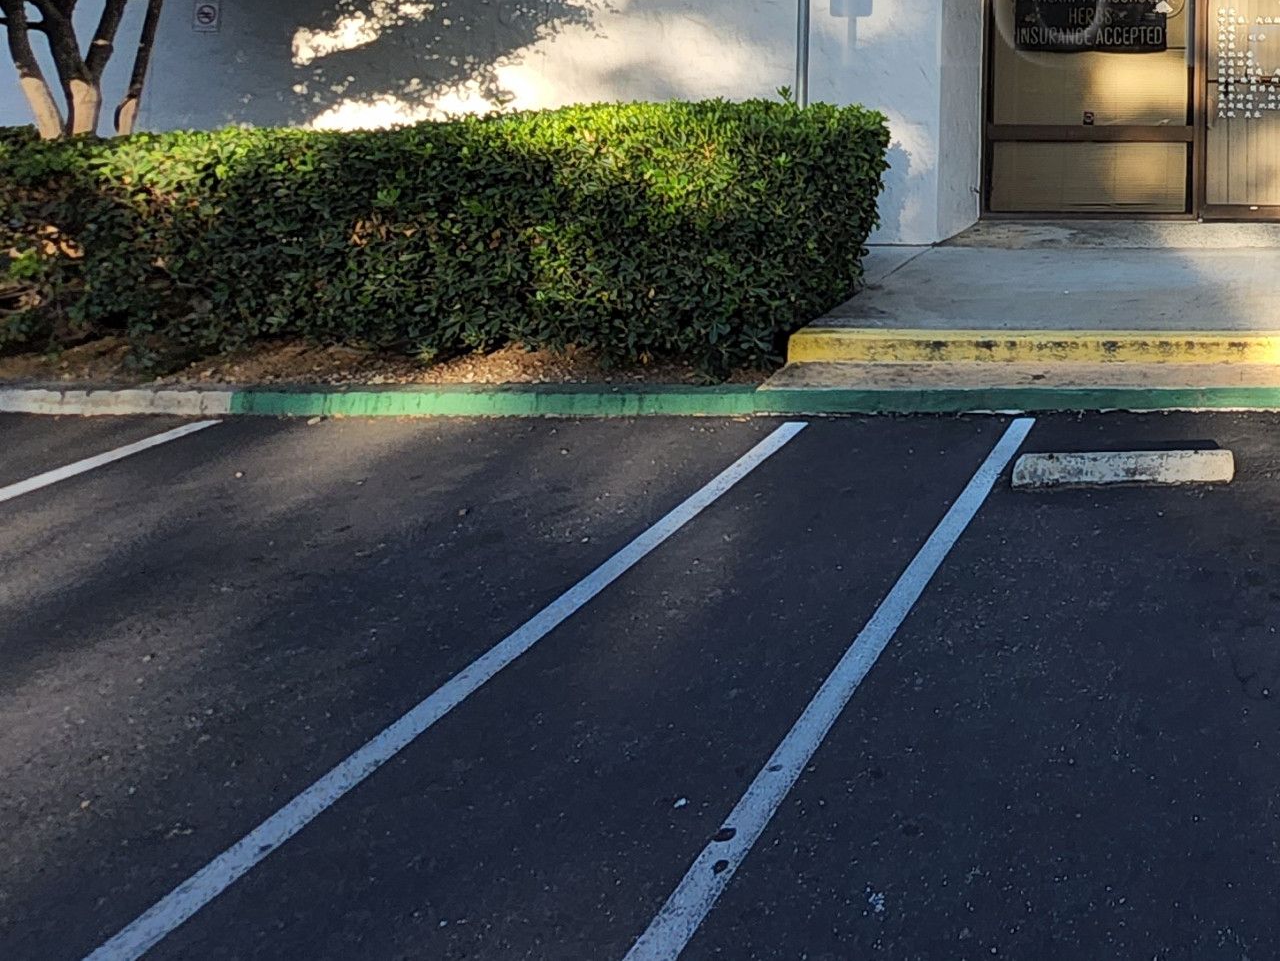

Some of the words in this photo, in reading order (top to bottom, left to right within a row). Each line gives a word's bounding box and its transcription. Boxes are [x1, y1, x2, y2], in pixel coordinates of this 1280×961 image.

[1068, 7, 1113, 25] HERBS
[1016, 26, 1093, 45] INSURANCE
[1095, 26, 1163, 45] ACCEPTED
